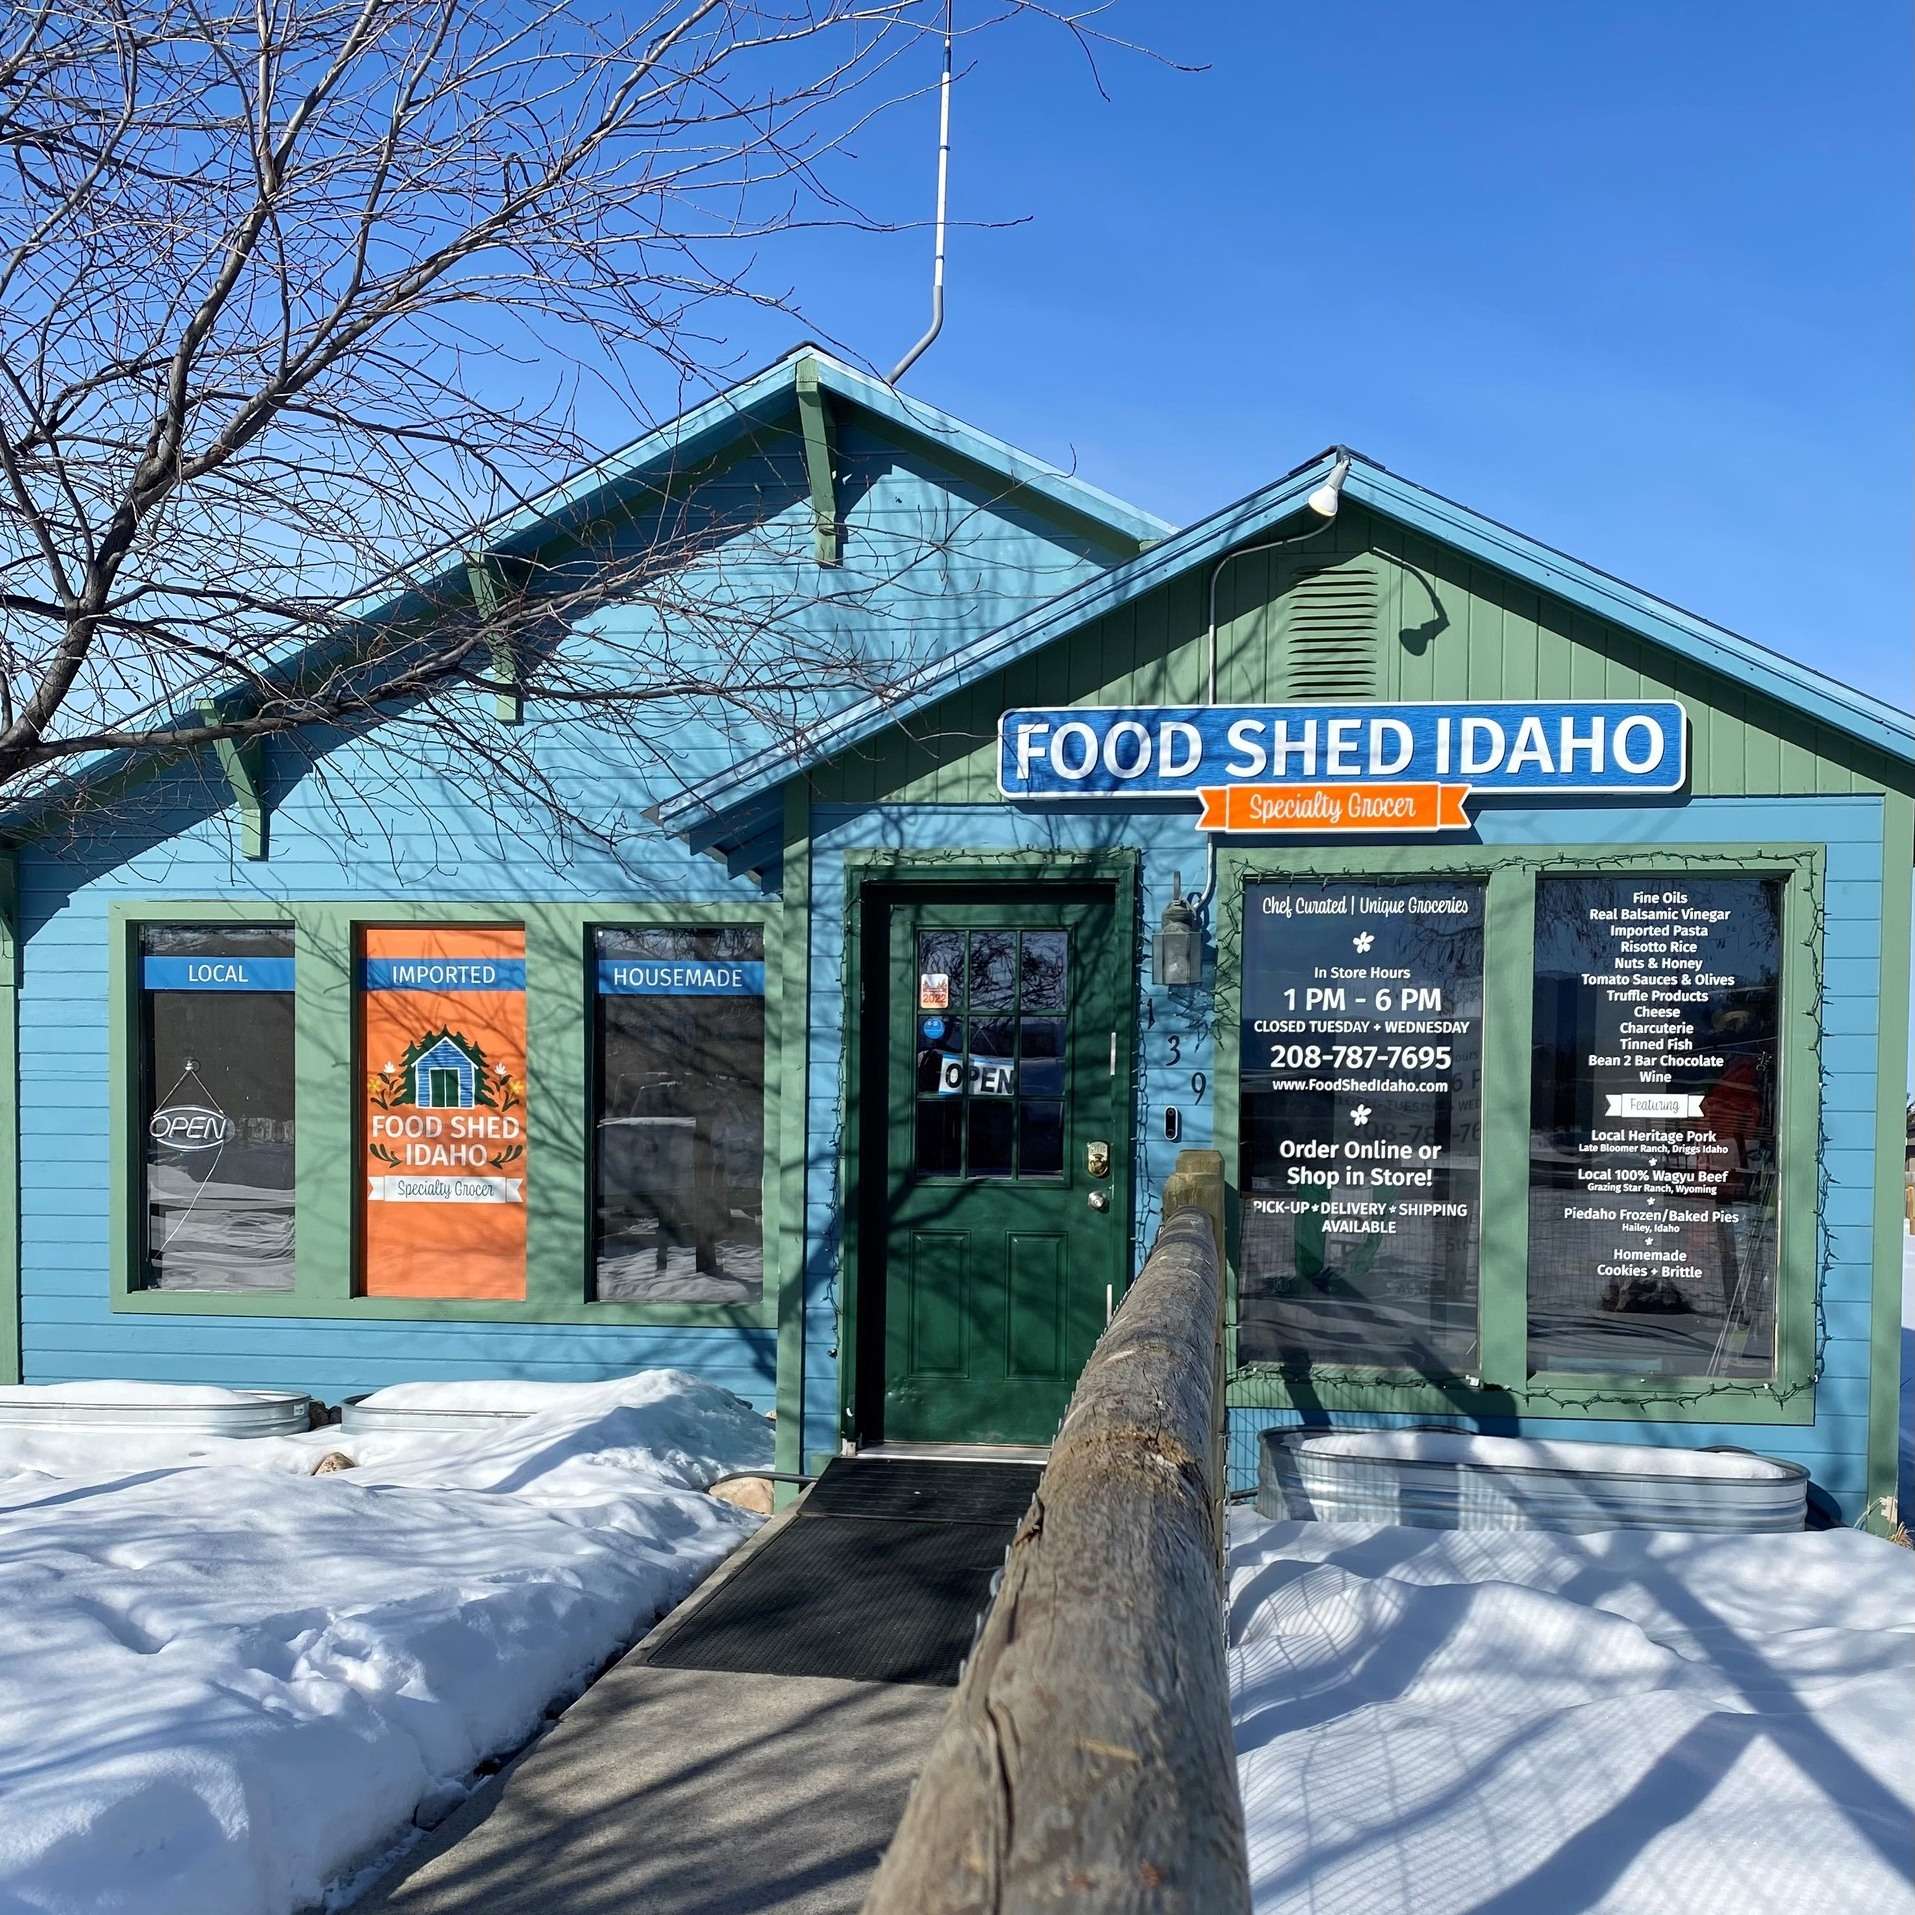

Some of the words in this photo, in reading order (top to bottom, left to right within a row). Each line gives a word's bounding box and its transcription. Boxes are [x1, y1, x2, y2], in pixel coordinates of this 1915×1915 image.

[1015, 722, 1202, 779] FOOD
[1225, 718, 1414, 777] SHED
[1435, 715, 1664, 775] IDAHO
[1249, 793, 1343, 822] Specialty
[1348, 790, 1416, 819] Grocer
[1634, 892, 1659, 903] Fine
[1663, 891, 1688, 903] Oils
[1263, 896, 1292, 918] Chef
[1296, 896, 1347, 913] Curated
[1360, 897, 1404, 917] Unique
[1408, 897, 1468, 913] Groceries
[1590, 908, 1617, 919] Real
[1621, 908, 1678, 919] Balsamic
[1681, 908, 1730, 922] Vinegar
[1611, 925, 1669, 938] Imported
[1674, 925, 1708, 936] Pasta
[1621, 941, 1666, 952] Risotto
[1671, 941, 1697, 952] Rice
[1615, 958, 1644, 968] Nuts
[1648, 958, 1658, 968] &
[1662, 958, 1702, 971] Honey
[190, 965, 248, 982] LOCAL
[392, 966, 495, 984] IMPORTED
[615, 968, 741, 986] HOUSEMADE
[1315, 967, 1326, 978] In
[1331, 967, 1366, 978] Store
[1371, 967, 1410, 978] Hours
[1582, 974, 1629, 985] Tomato
[1633, 974, 1677, 985] Sauces
[1681, 974, 1691, 985] &
[1695, 973, 1734, 985] Olives
[923, 994, 946, 1004] 2022
[1284, 989, 1295, 1010] 1
[1306, 988, 1345, 1010] PM
[1376, 989, 1391, 1011] 6
[1402, 988, 1441, 1011] PM
[1607, 990, 1648, 1001] Truffle
[1652, 990, 1708, 1001] Products
[1634, 1006, 1680, 1017] Cheese
[1255, 1021, 1305, 1032] CLOSED
[1309, 1021, 1370, 1032] TUESDAY
[1385, 1021, 1469, 1033] WEDNESDAY
[1620, 1022, 1693, 1033] Charcuterie
[1620, 1038, 1663, 1050] Tinned
[1668, 1038, 1692, 1050] Fish
[1271, 1045, 1451, 1069] 208-787-7695
[1589, 1055, 1620, 1066] Bean
[1624, 1055, 1631, 1066] 2
[1635, 1055, 1657, 1066] Bar
[1660, 1055, 1723, 1066] Chocolate
[1640, 1070, 1671, 1082] Wine
[1273, 1079, 1448, 1092] www.FoodShedIdaho.com
[1630, 1098, 1680, 1112] Featuring
[150, 1116, 227, 1139] OPEN
[372, 1116, 442, 1138] FOOD
[451, 1117, 520, 1138] SHED
[1592, 1130, 1625, 1141] Local
[1629, 1130, 1683, 1144] Heritage
[1687, 1131, 1716, 1143] Pork
[406, 1144, 487, 1166] IDAHO
[1280, 1140, 1339, 1158] Order
[1345, 1140, 1412, 1159] Online
[1419, 1145, 1441, 1159] or
[1579, 1144, 1598, 1152] Late
[1601, 1144, 1638, 1153] Bloomer
[1640, 1144, 1670, 1154] Ranch,
[1673, 1145, 1700, 1155] Driggs
[1703, 1145, 1728, 1153] Idaho
[1288, 1166, 1339, 1189] Shop
[1346, 1166, 1364, 1185] in
[1371, 1168, 1432, 1186] Store!
[1578, 1169, 1611, 1180] Local
[1614, 1169, 1649, 1181] 100%
[1653, 1171, 1694, 1184] Wagyu
[1698, 1171, 1728, 1183] Beef
[398, 1181, 451, 1198] Specialty
[455, 1181, 494, 1197] Grocer
[1588, 1183, 1621, 1193] Grazing
[1623, 1184, 1642, 1192] Star
[1644, 1184, 1674, 1193] Ranch,
[1676, 1185, 1717, 1194] Wyoming
[1254, 1201, 1310, 1213] PICK-UP
[1321, 1203, 1386, 1215] DELIVERY
[1399, 1204, 1468, 1216] SHIPPING
[1565, 1208, 1616, 1220] Piedaho
[1620, 1209, 1708, 1222] Frozen/Baked
[1712, 1210, 1739, 1222] Pies
[1322, 1221, 1396, 1233] AVAILABLE
[1622, 1224, 1652, 1233] Hailey,
[1654, 1224, 1680, 1232] Idaho
[1614, 1249, 1687, 1261] Homemade
[1597, 1265, 1647, 1276] Cookies
[1661, 1266, 1703, 1278] Brittle
